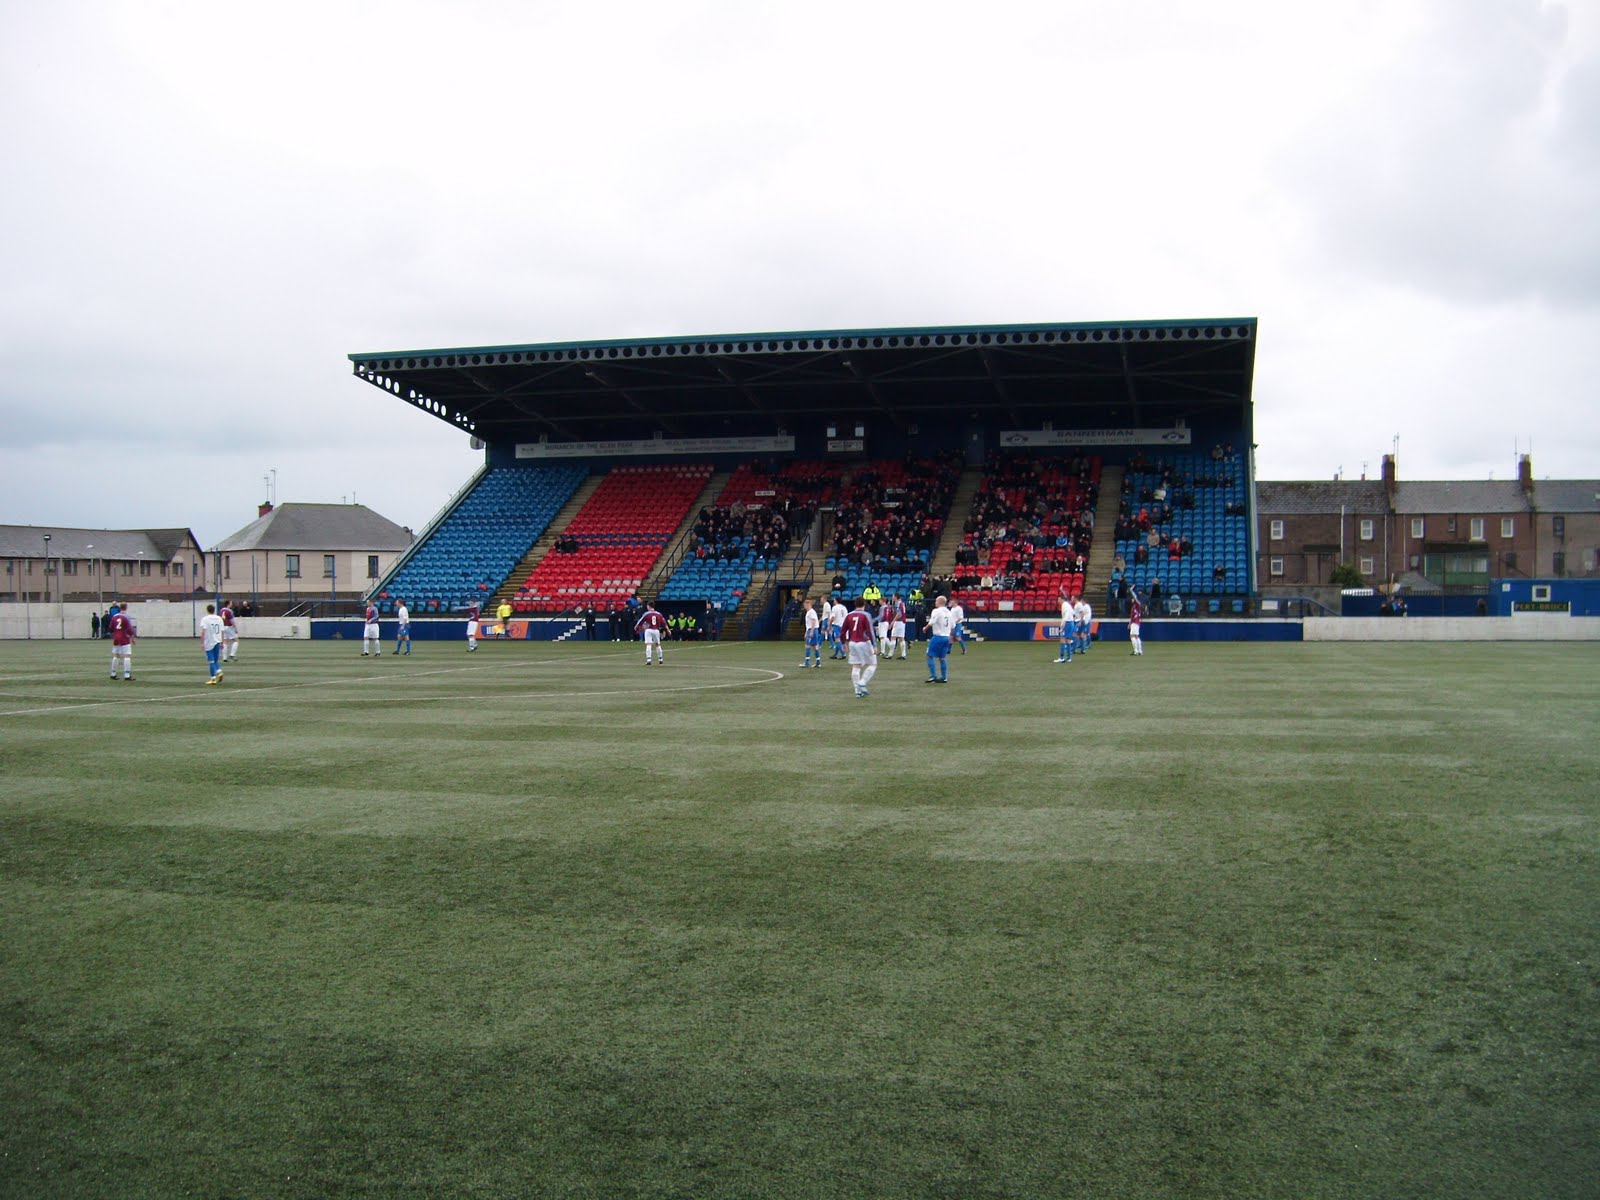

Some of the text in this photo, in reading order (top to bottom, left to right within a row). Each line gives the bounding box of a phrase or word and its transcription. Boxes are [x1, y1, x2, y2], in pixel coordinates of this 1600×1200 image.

[1056, 430, 1134, 438] BANNERMAN
[116, 618, 122, 629] 2
[651, 615, 657, 626] 8
[852, 616, 859, 631] 7
[944, 616, 949, 627] 3
